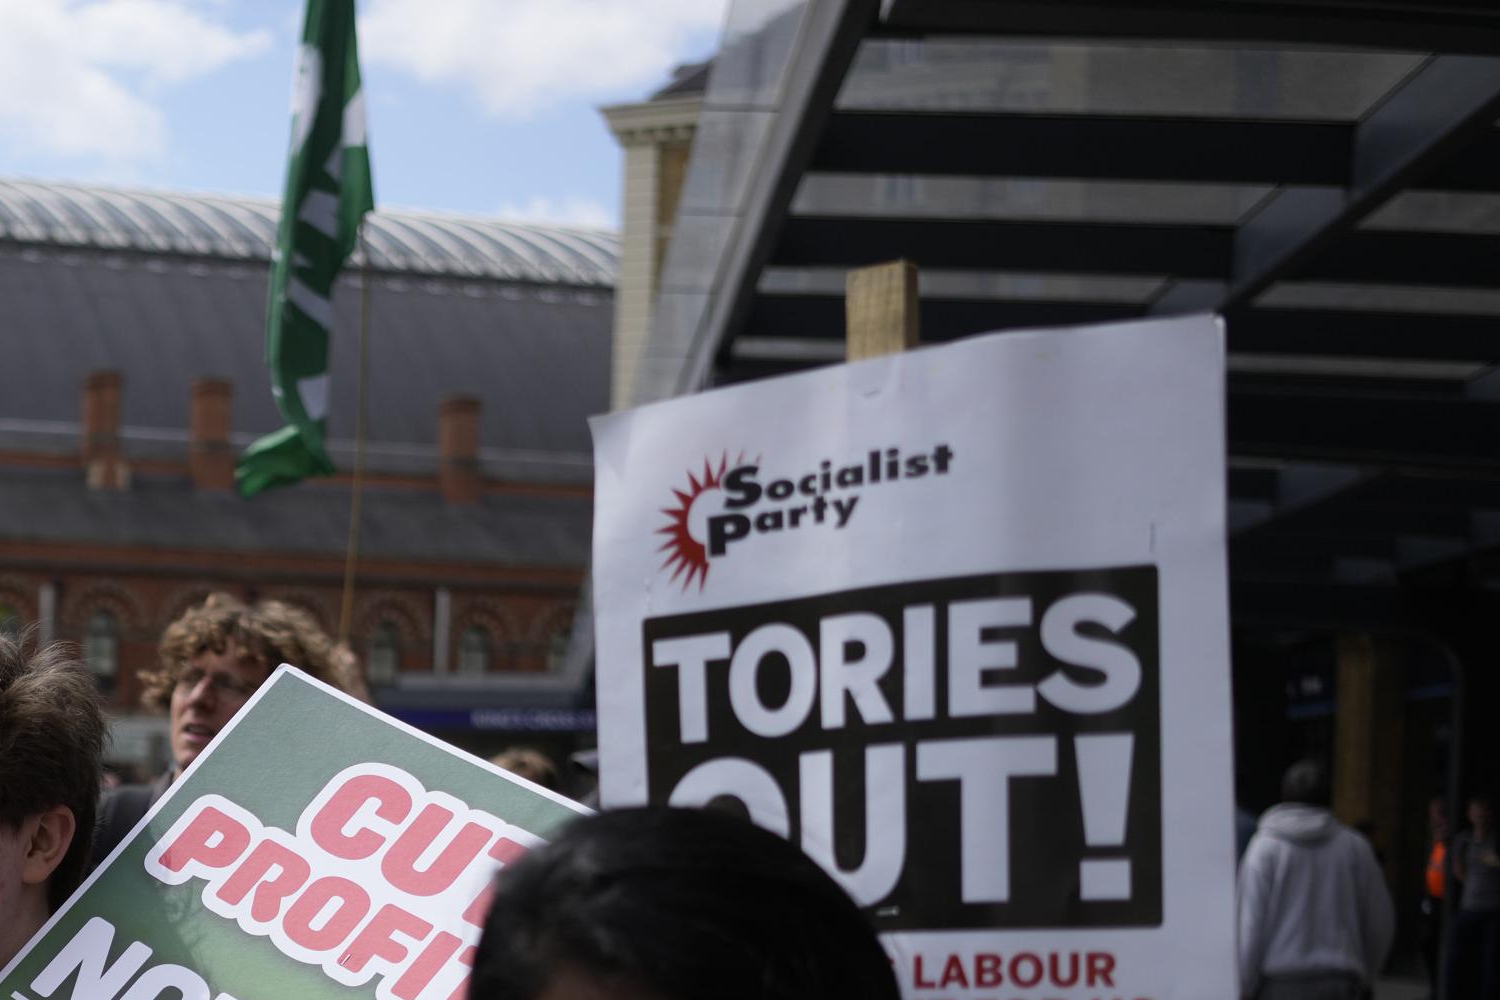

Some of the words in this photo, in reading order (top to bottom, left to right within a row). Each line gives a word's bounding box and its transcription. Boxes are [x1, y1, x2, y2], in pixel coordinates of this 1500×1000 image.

[722, 444, 955, 511] Socialist
[707, 495, 860, 558] Party
[652, 592, 1142, 743] TORIES
[912, 952, 1118, 990] LABOUR
